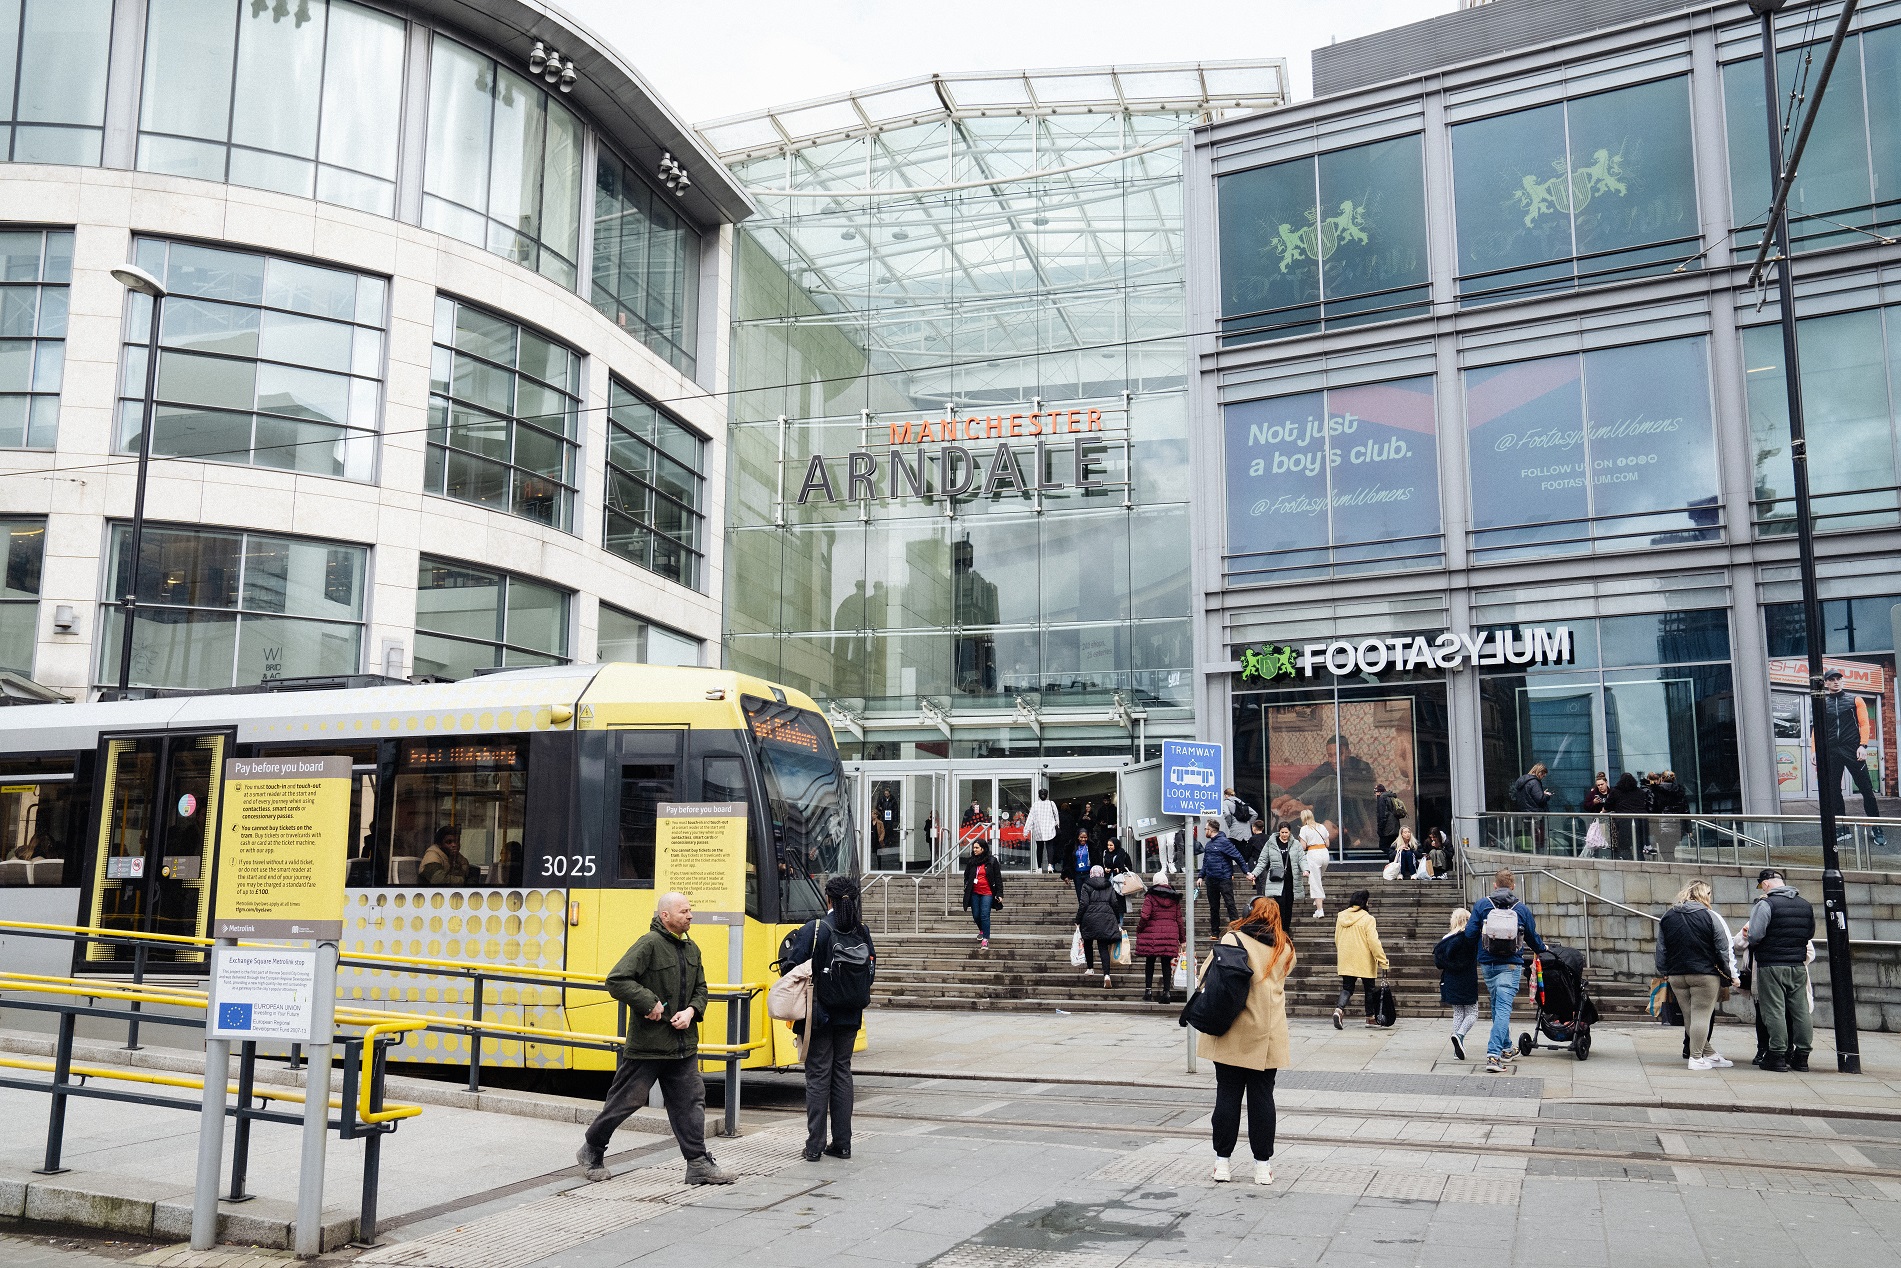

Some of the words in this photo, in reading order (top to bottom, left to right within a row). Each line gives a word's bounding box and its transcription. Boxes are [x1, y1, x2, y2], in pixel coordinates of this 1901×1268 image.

[889, 408, 1102, 445] MANCHESTER
[1248, 421, 1298, 446] Not
[1297, 412, 1359, 446] just
[1250, 458, 1265, 476] a
[1272, 445, 1342, 476] boy's
[1350, 436, 1412, 464] club.
[797, 436, 1103, 504] ARNDALE
[1521, 464, 1571, 477] FOLLOW
[1594, 459, 1613, 469] ON
[1171, 746, 1215, 756] TRAMWAY
[235, 763, 250, 775] Pay
[252, 762, 280, 772] before
[281, 764, 297, 775] you
[299, 761, 324, 771] board
[1167, 789, 1191, 798] LOOK
[1194, 791, 1218, 800] BOTH
[666, 806, 677, 815] Pay
[1180, 801, 1205, 810] WAYS
[229, 957, 252, 965] Exchange
